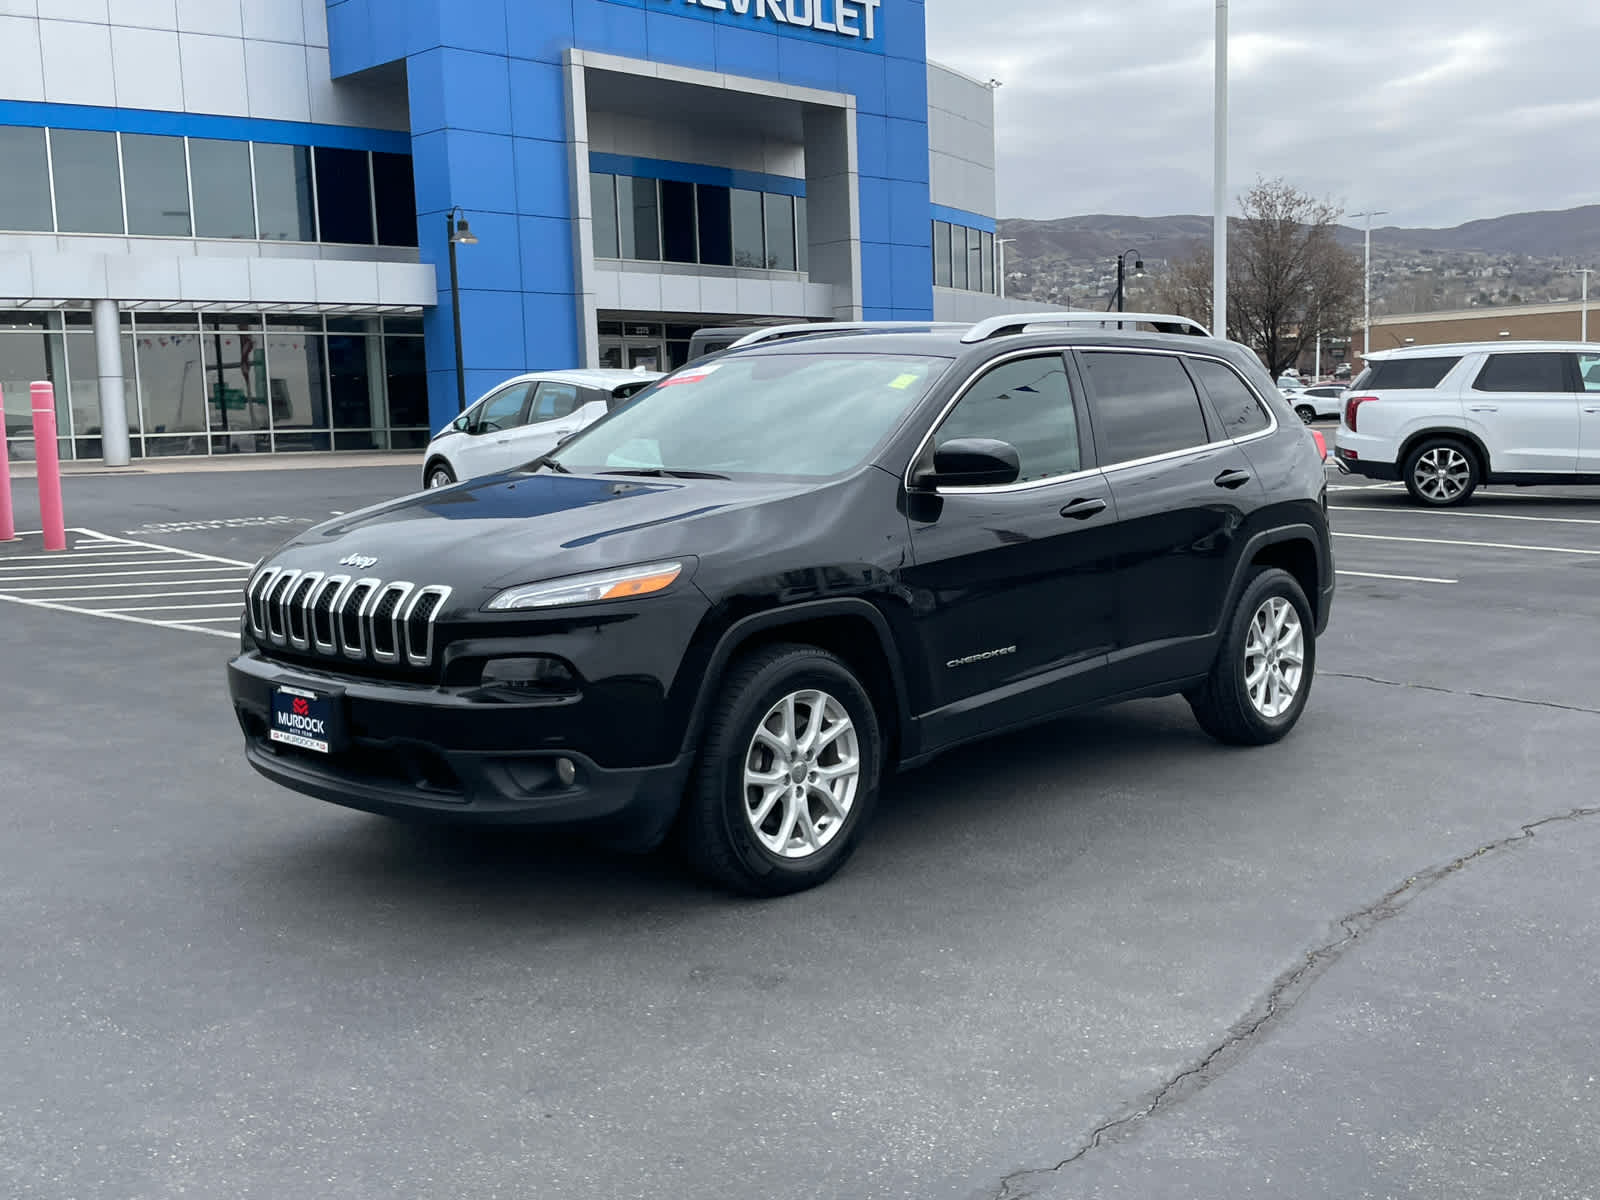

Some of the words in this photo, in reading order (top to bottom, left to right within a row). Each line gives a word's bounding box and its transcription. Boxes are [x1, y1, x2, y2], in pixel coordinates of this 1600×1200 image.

[339, 552, 377, 569] Jeep
[946, 645, 1017, 668] CHEROKEE
[278, 711, 324, 734] MURDOCK
